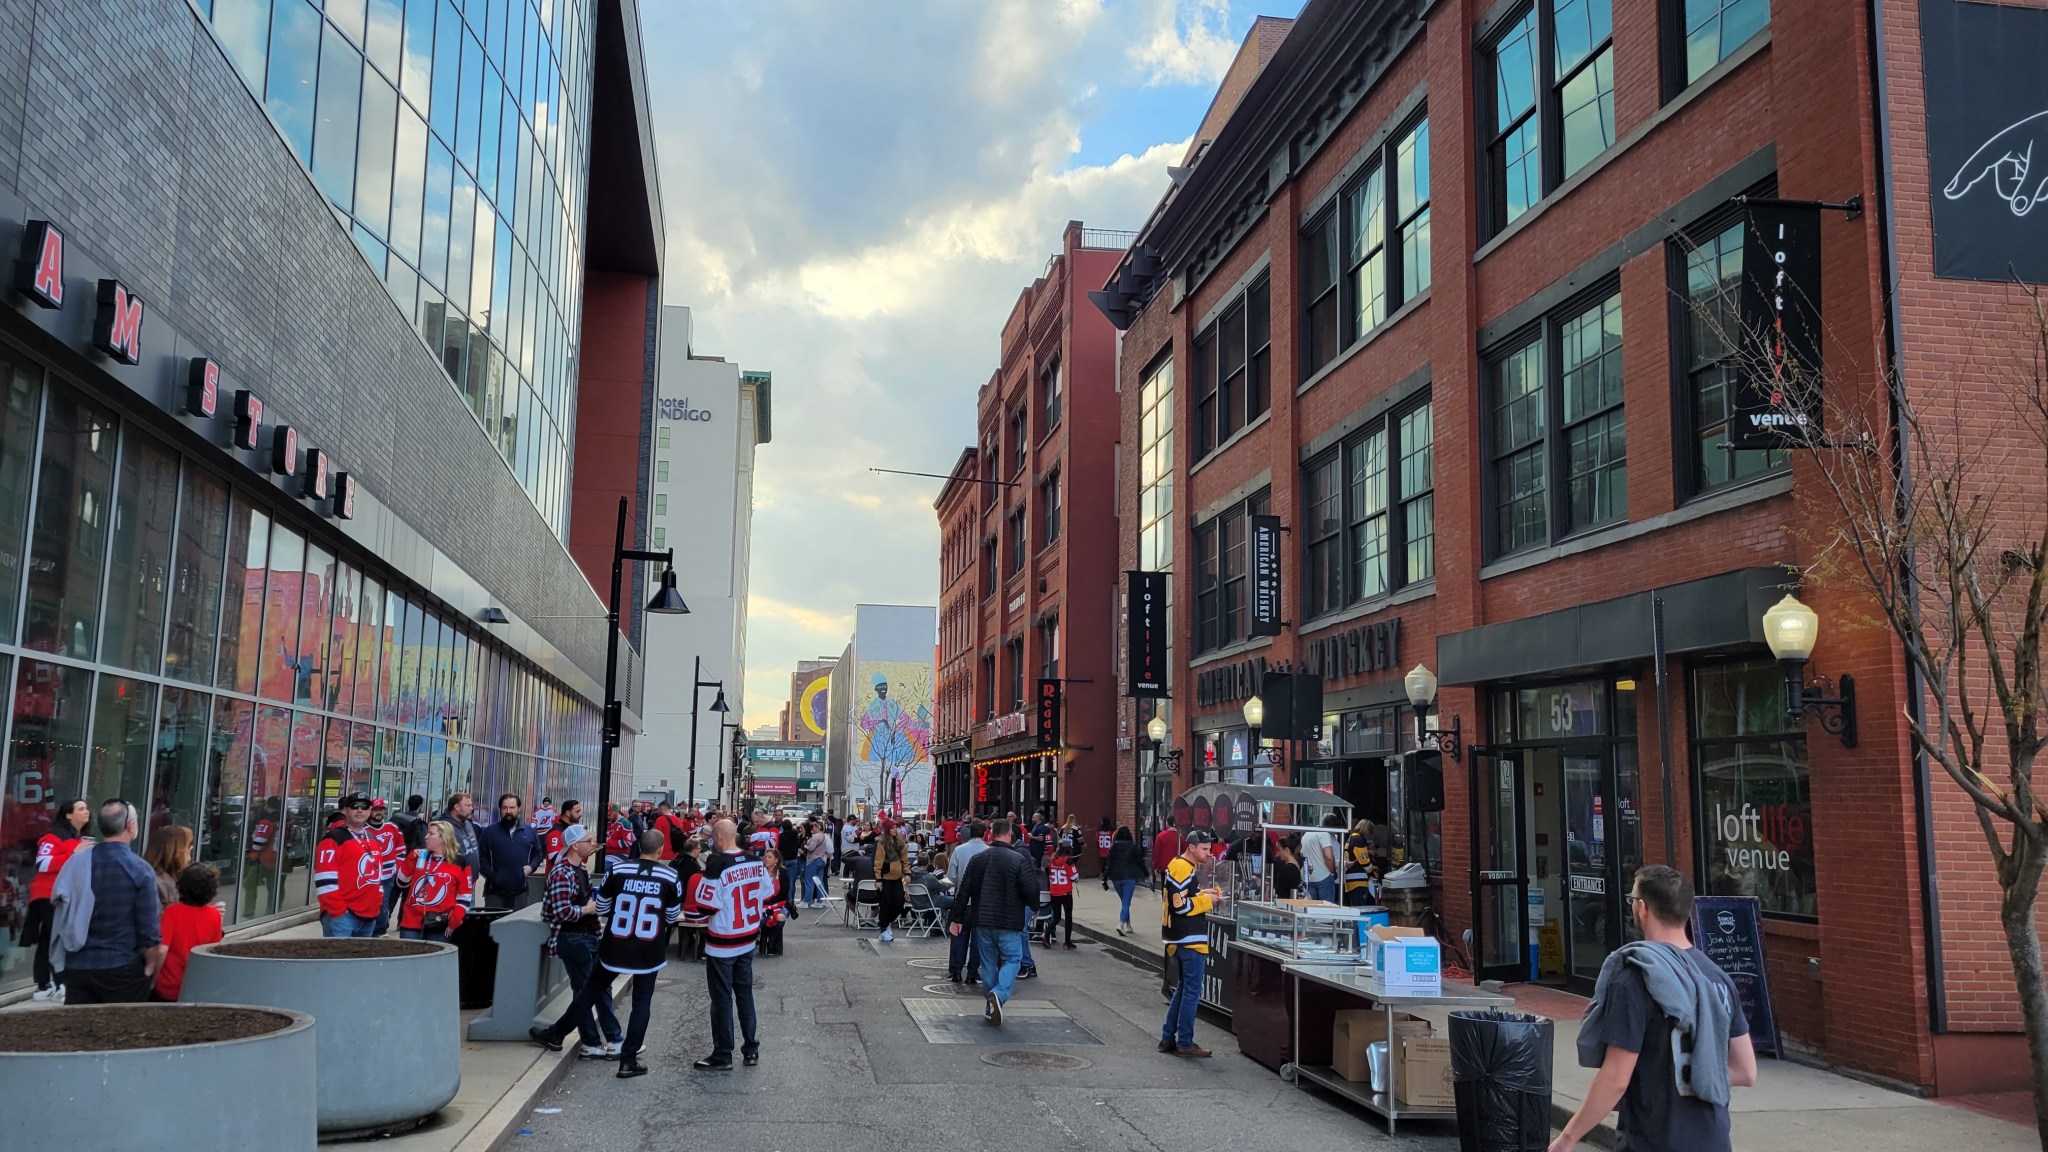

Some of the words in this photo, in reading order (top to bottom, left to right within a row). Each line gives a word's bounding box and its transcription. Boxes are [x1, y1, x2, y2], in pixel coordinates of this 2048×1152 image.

[1750, 411, 1808, 426] venue
[192, 357, 357, 520] STORE
[1259, 526, 1269, 575] AMERICAN
[1259, 580, 1270, 624] WHISKEY
[1198, 657, 1265, 706] AMERICAN
[1309, 619, 1401, 681] WHISKEY
[1137, 681, 1159, 690] venue
[1551, 692, 1573, 732] 53
[756, 748, 805, 756] PORTA
[895, 780, 903, 818] PARKIN
[319, 849, 335, 863] 17
[1098, 835, 1112, 849] 86
[1725, 847, 1790, 871] venue
[623, 878, 661, 895] HUGHES
[698, 883, 715, 901] 15
[1573, 877, 1602, 892] ENTRANCE
[611, 893, 662, 941] 86
[731, 881, 761, 930] 15
[1207, 920, 1229, 960] ICAN
[1200, 973, 1223, 1006] SKEY
